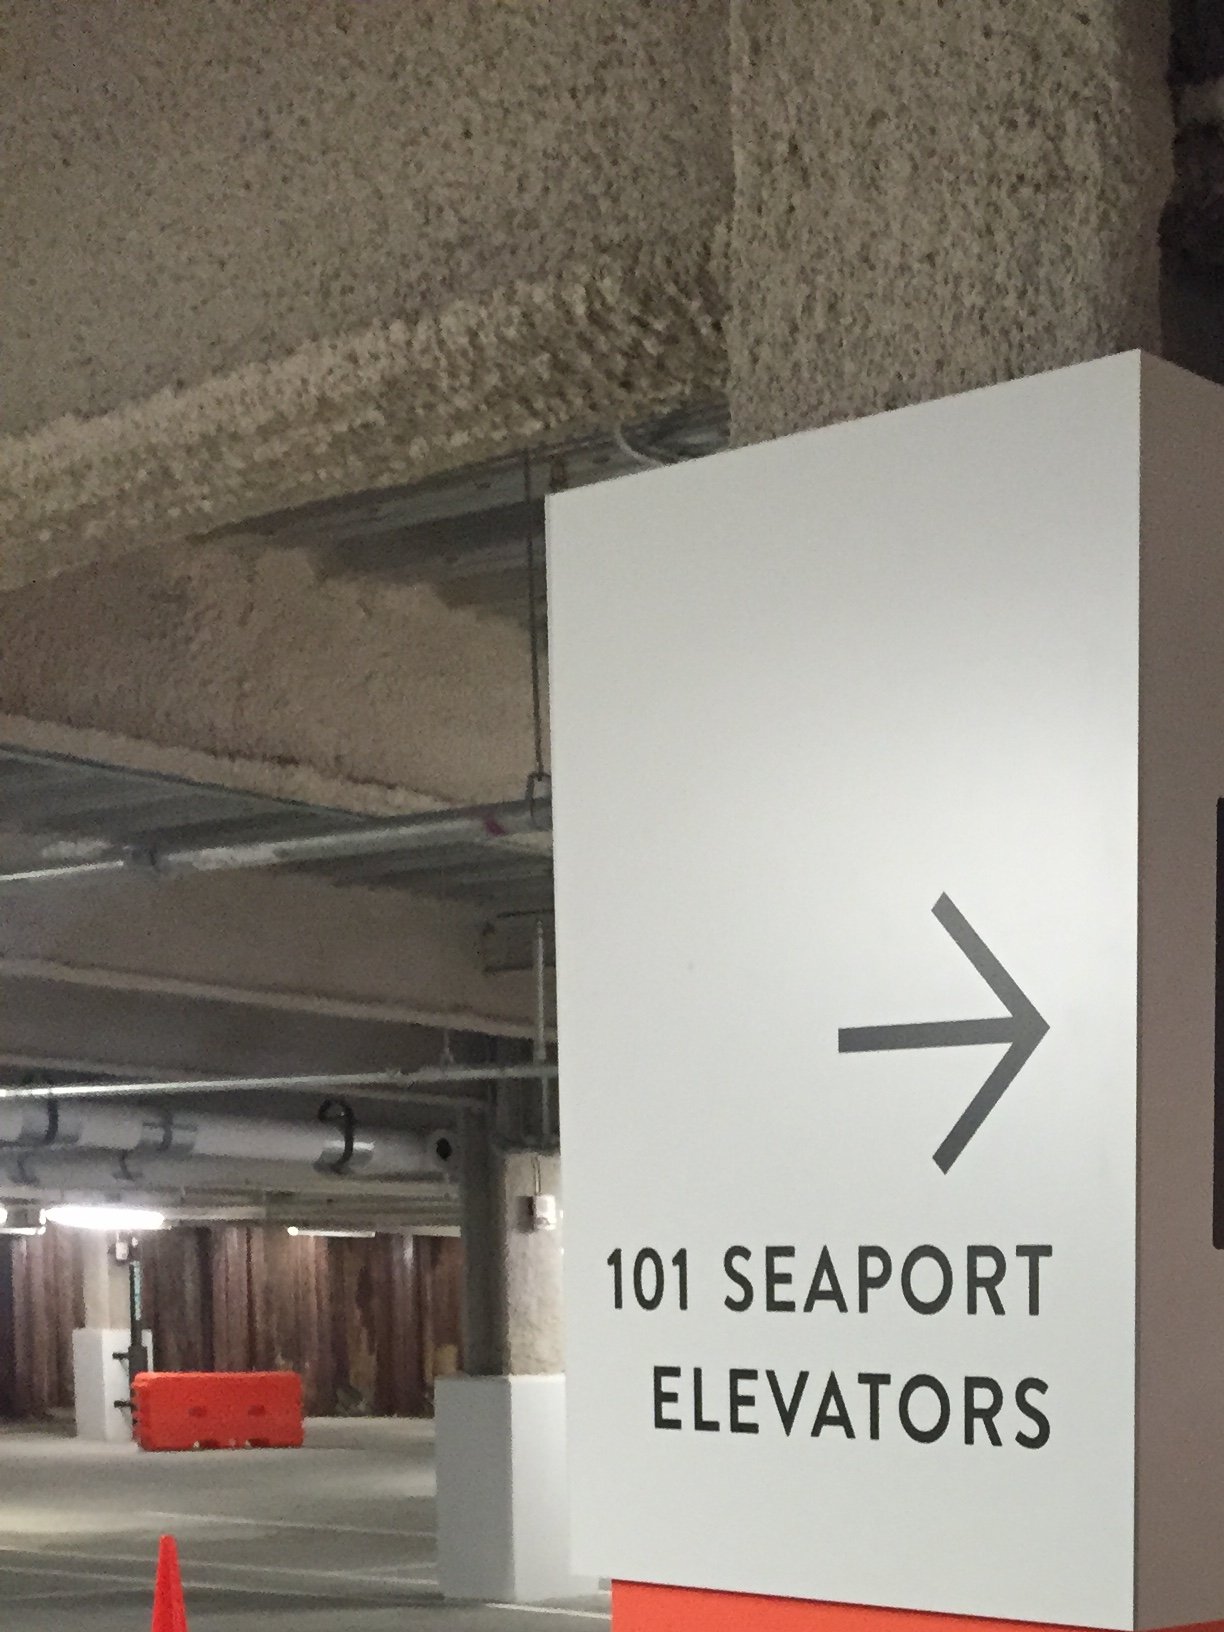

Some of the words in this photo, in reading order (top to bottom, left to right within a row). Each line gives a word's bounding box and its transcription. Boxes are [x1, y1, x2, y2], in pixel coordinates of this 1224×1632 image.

[607, 1246, 688, 1311] 101
[723, 1244, 1053, 1316] SEAPORT
[653, 1365, 1051, 1450] ELEVATORS
